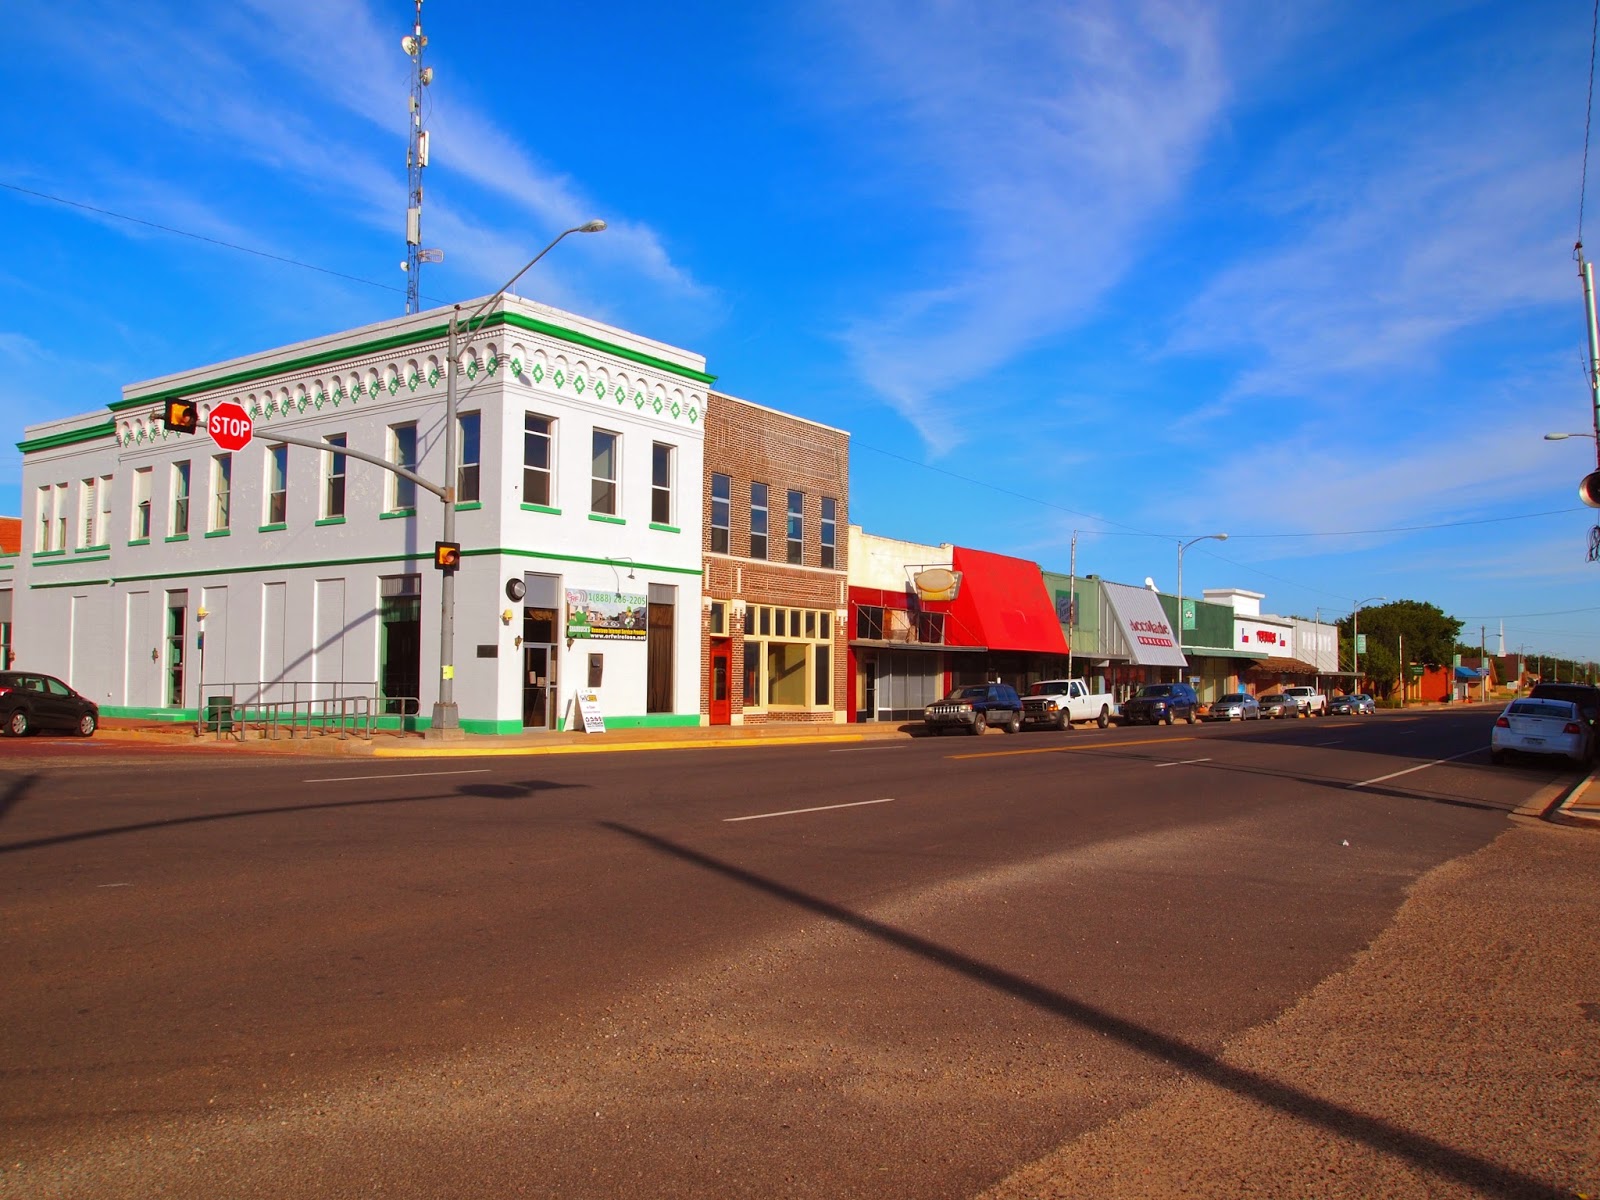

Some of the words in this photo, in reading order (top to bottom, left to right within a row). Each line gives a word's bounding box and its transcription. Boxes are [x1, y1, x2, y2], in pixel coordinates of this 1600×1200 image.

[211, 415, 251, 438] STOP
[588, 592, 611, 604] 1(888)
[1129, 619, 1170, 634] Accolade
